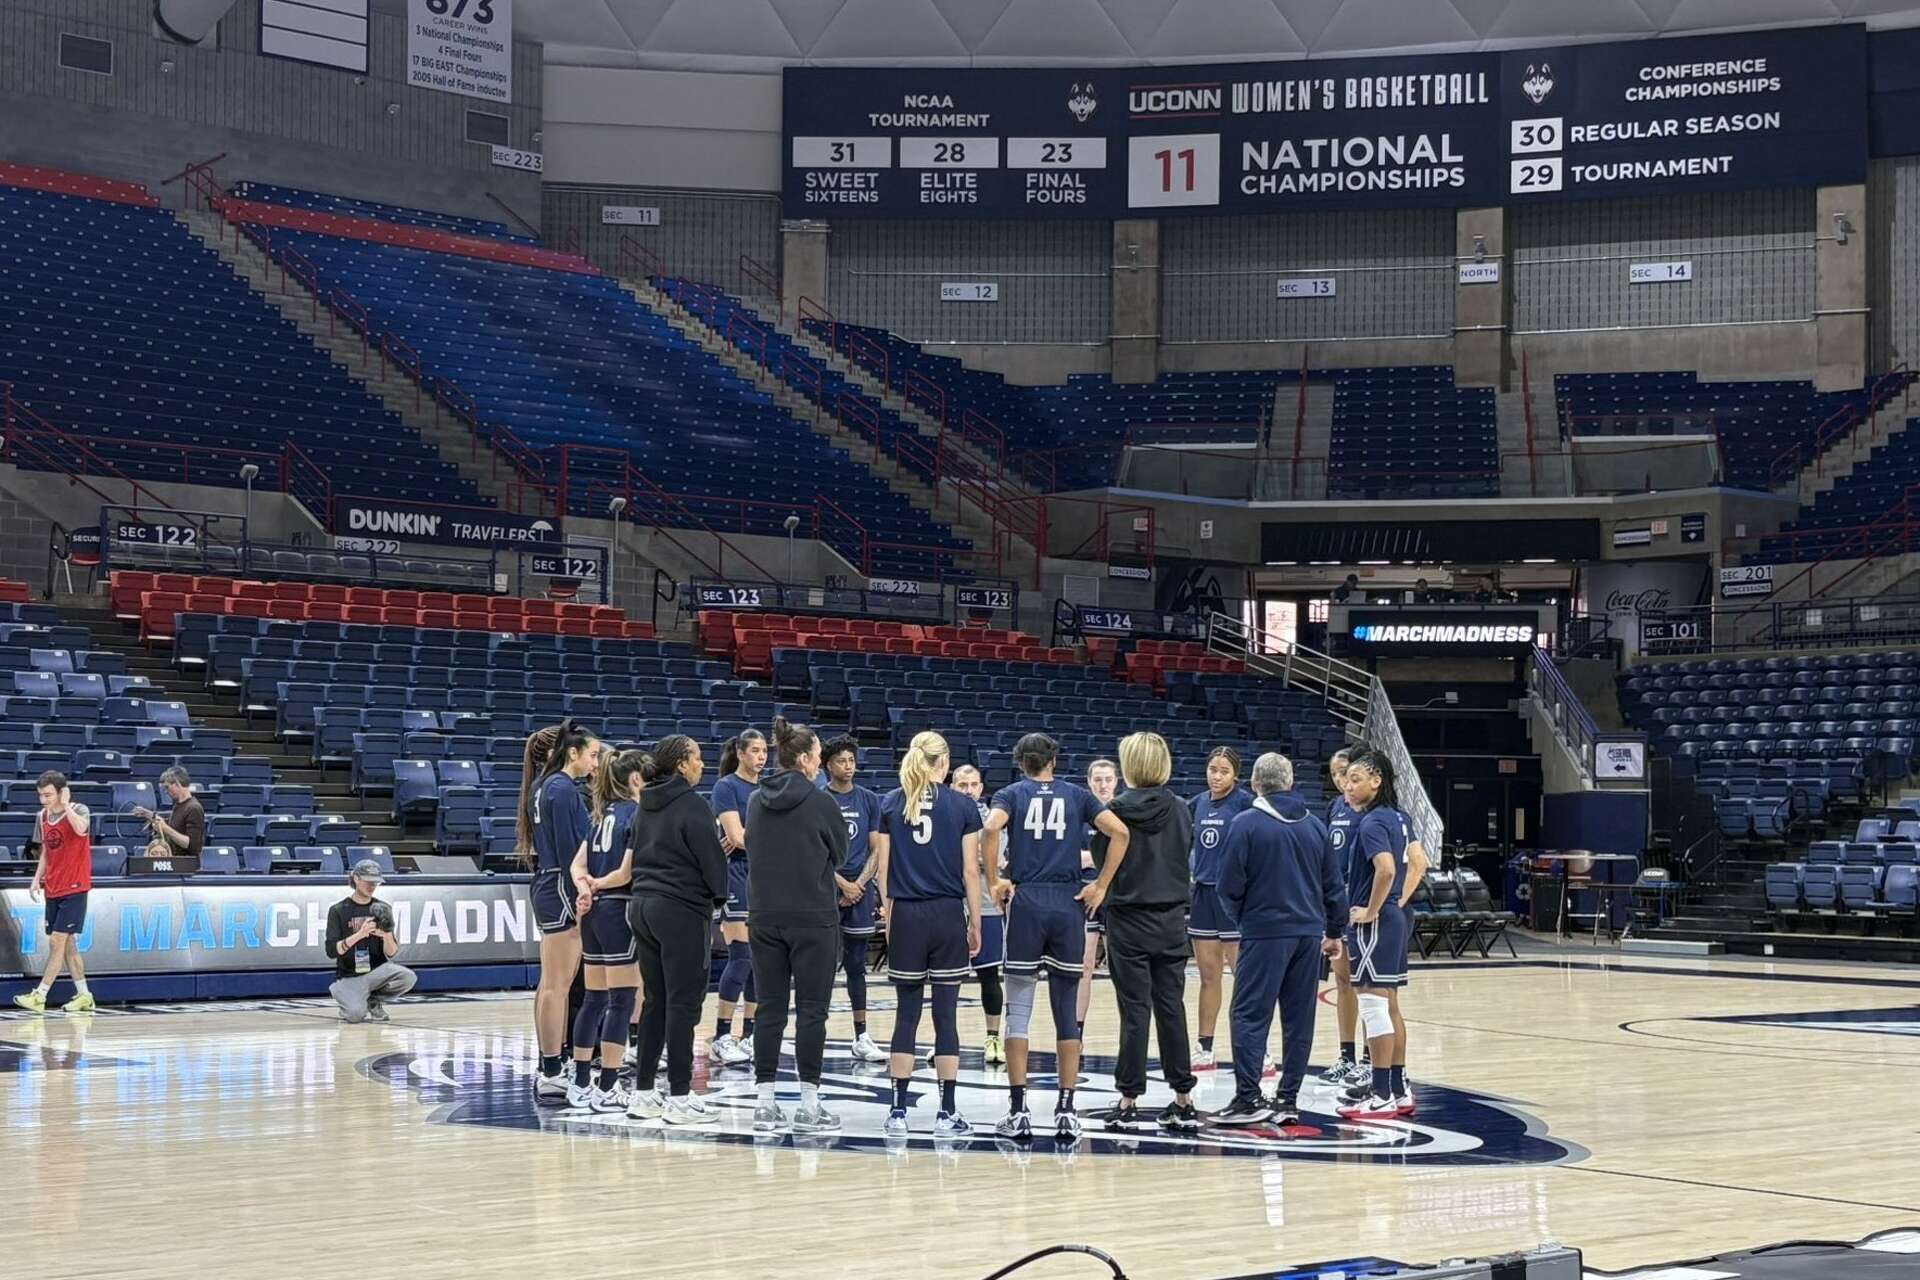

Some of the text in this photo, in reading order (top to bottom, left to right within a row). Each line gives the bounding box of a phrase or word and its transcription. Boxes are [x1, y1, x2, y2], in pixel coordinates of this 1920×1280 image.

[416, 24, 504, 52] 3 National Championships
[438, 46, 482, 63] 4 Final Fours
[412, 55, 507, 83] 17 BIG EAST Championships
[1639, 58, 1767, 81] CONFERENCE
[412, 70, 431, 83] 2005
[433, 74, 447, 87] Hall
[447, 78, 455, 88] of
[456, 80, 475, 92] Fame
[1625, 77, 1782, 102] CHAMPIONSHIPS
[904, 94, 954, 108] NCAA
[1129, 72, 1489, 114] UCONN WOMEN'S BASKETBALL
[868, 114, 990, 127] TOURNAMENT
[1518, 112, 1782, 147] 30 REGULAR SEASON
[493, 151, 542, 169] SEC 223
[830, 141, 855, 163] 31
[933, 142, 965, 163] 28
[1041, 142, 1073, 163] 23
[1242, 133, 1464, 172] NATIONAL
[1154, 148, 1196, 193] 11
[1518, 155, 1733, 187] 29 TOURNAMENT
[805, 172, 879, 188] SWEET
[920, 172, 978, 188] ELITE
[1026, 172, 1086, 188] FINAL
[1240, 166, 1466, 195] CHAMPIONSHIPS
[805, 190, 879, 203] SIXTEENS
[920, 190, 978, 203] EIGHTS
[1026, 189, 1086, 203] FOURS
[604, 210, 653, 223] SEC 11
[1460, 267, 1497, 279] NORTH
[1631, 264, 1687, 279] SEC 14
[942, 286, 992, 299] SEC 12
[1279, 281, 1330, 295] SEC 13
[350, 508, 537, 542] DUNKIN' TRAVELERS
[72, 535, 100, 543] SECURI
[119, 525, 196, 546] SEC 122
[336, 540, 398, 553] SEC 222
[534, 559, 596, 577] SEC 122
[1722, 566, 1771, 580] SEC 201
[703, 589, 760, 604] SEC 123
[960, 591, 1009, 606] SEC 123
[1085, 613, 1132, 628] SEC 124
[1353, 625, 1533, 642] #MARCHMADNESS
[1645, 623, 1697, 637] SEC 101
[912, 801, 933, 845] 5
[1023, 797, 1067, 840] 44
